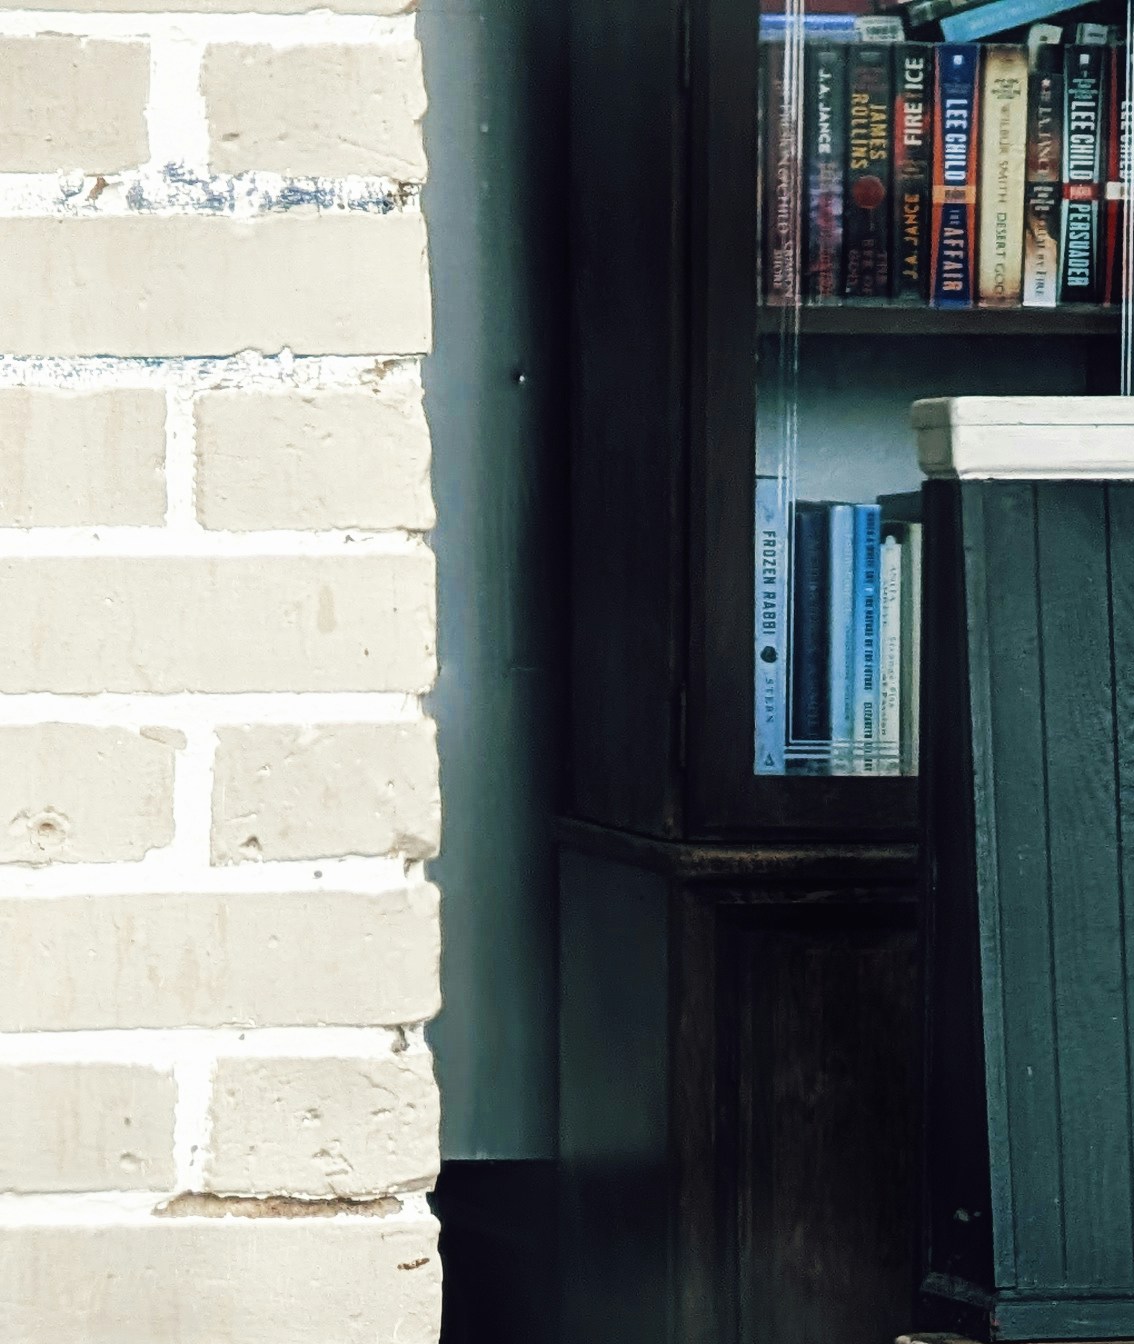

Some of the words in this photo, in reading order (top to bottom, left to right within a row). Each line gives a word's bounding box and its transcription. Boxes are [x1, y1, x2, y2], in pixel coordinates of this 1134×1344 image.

[904, 57, 924, 89] ICE
[818, 102, 832, 154] JANCE
[849, 93, 869, 170] ROLLINS
[868, 103, 887, 160] JAMES
[903, 102, 923, 146] FIRE
[945, 99, 968, 129] LEE
[1070, 102, 1095, 129] LEE
[944, 134, 967, 180] CHILD
[1068, 134, 1094, 180] CHILD
[998, 161, 1009, 203] SMITH
[903, 193, 920, 246] JANCE
[995, 212, 1007, 257] DESERT
[942, 227, 964, 291] AFFAIR
[1067, 204, 1090, 287] PERSUADER
[994, 263, 1006, 295] GOD
[1035, 270, 1047, 297] FIRE
[762, 531, 776, 585] FROZEN
[762, 591, 776, 636] RABBI
[765, 678, 775, 723] STERN
